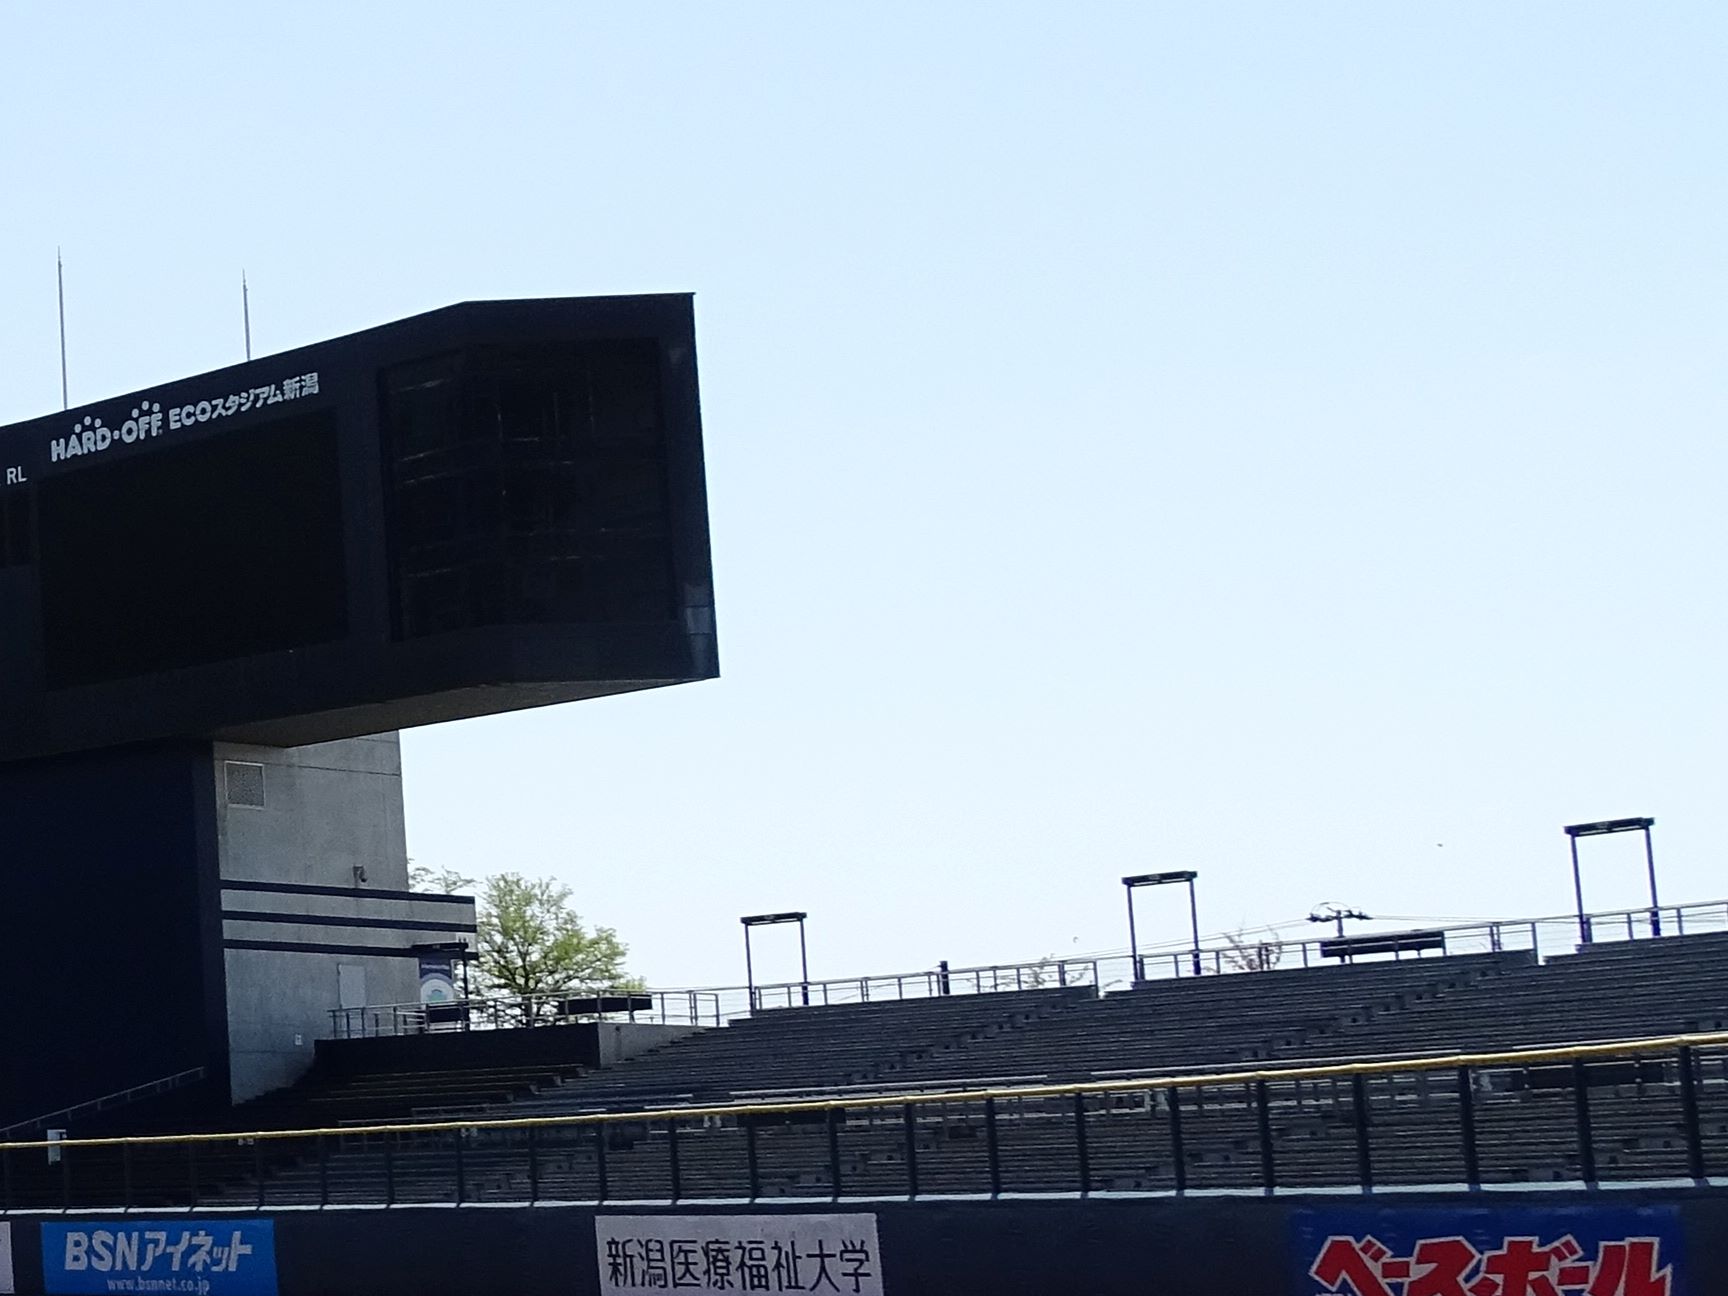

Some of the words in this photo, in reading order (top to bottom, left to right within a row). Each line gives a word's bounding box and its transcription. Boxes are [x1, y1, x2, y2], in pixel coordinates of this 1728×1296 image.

[6, 465, 28, 485] RL
[64, 1230, 253, 1272] BSNアイネット
[605, 1237, 871, 1293] 新潟医療福祉大学
